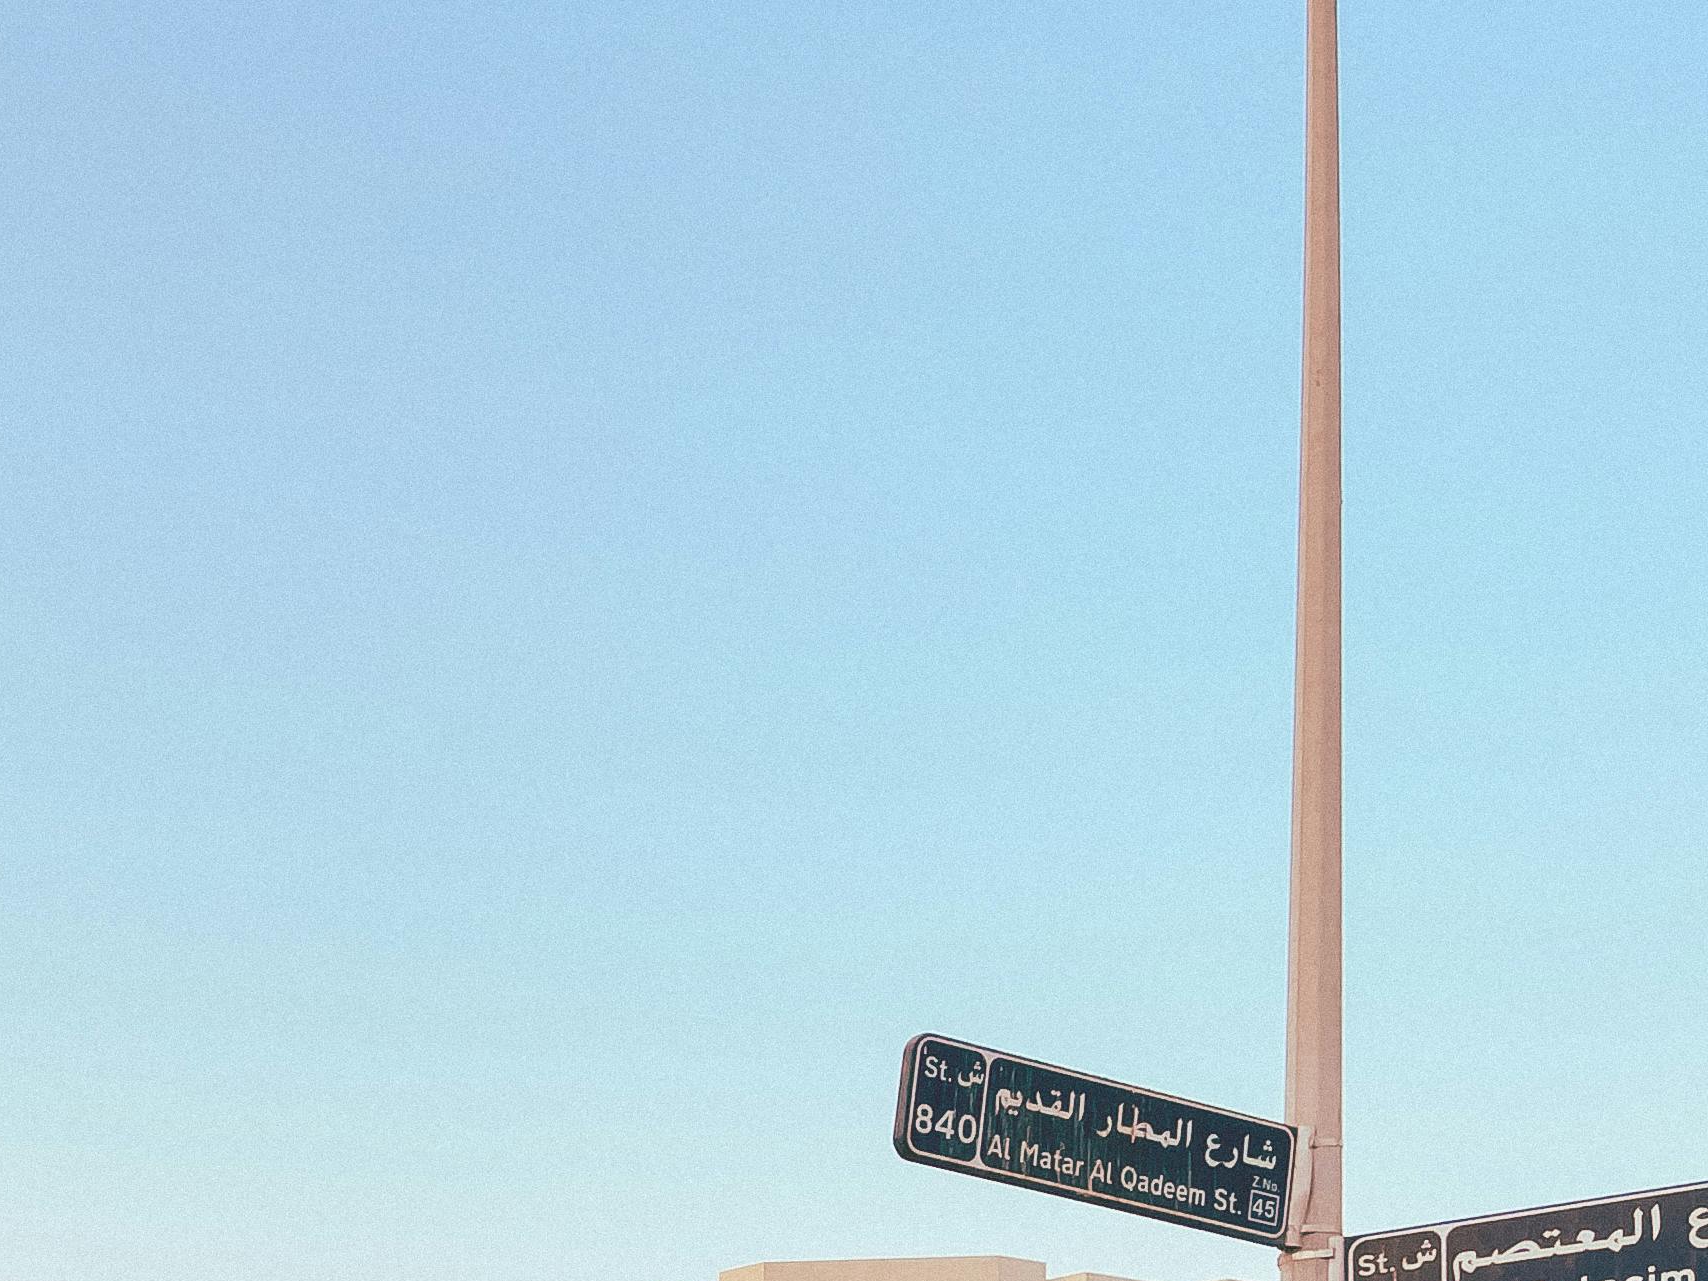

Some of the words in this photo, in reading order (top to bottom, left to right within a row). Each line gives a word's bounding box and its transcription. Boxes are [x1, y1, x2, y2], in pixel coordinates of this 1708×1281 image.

[924, 1056, 952, 1083] St.
[957, 1061, 985, 1087] ش
[995, 1088, 1086, 1121] القديم
[915, 1103, 977, 1144] 840
[1096, 1103, 1193, 1149] المطار
[1204, 1134, 1277, 1170] شارع
[987, 1134, 1011, 1161] Al
[1020, 1140, 1084, 1177] Matar
[1091, 1159, 1113, 1185] Al
[1120, 1165, 1206, 1207] Qadeem
[1213, 1188, 1243, 1215] St.
[1252, 1198, 1275, 1218] 45
[1358, 1252, 1396, 1277] St.
[1401, 1239, 1437, 1271] ش
